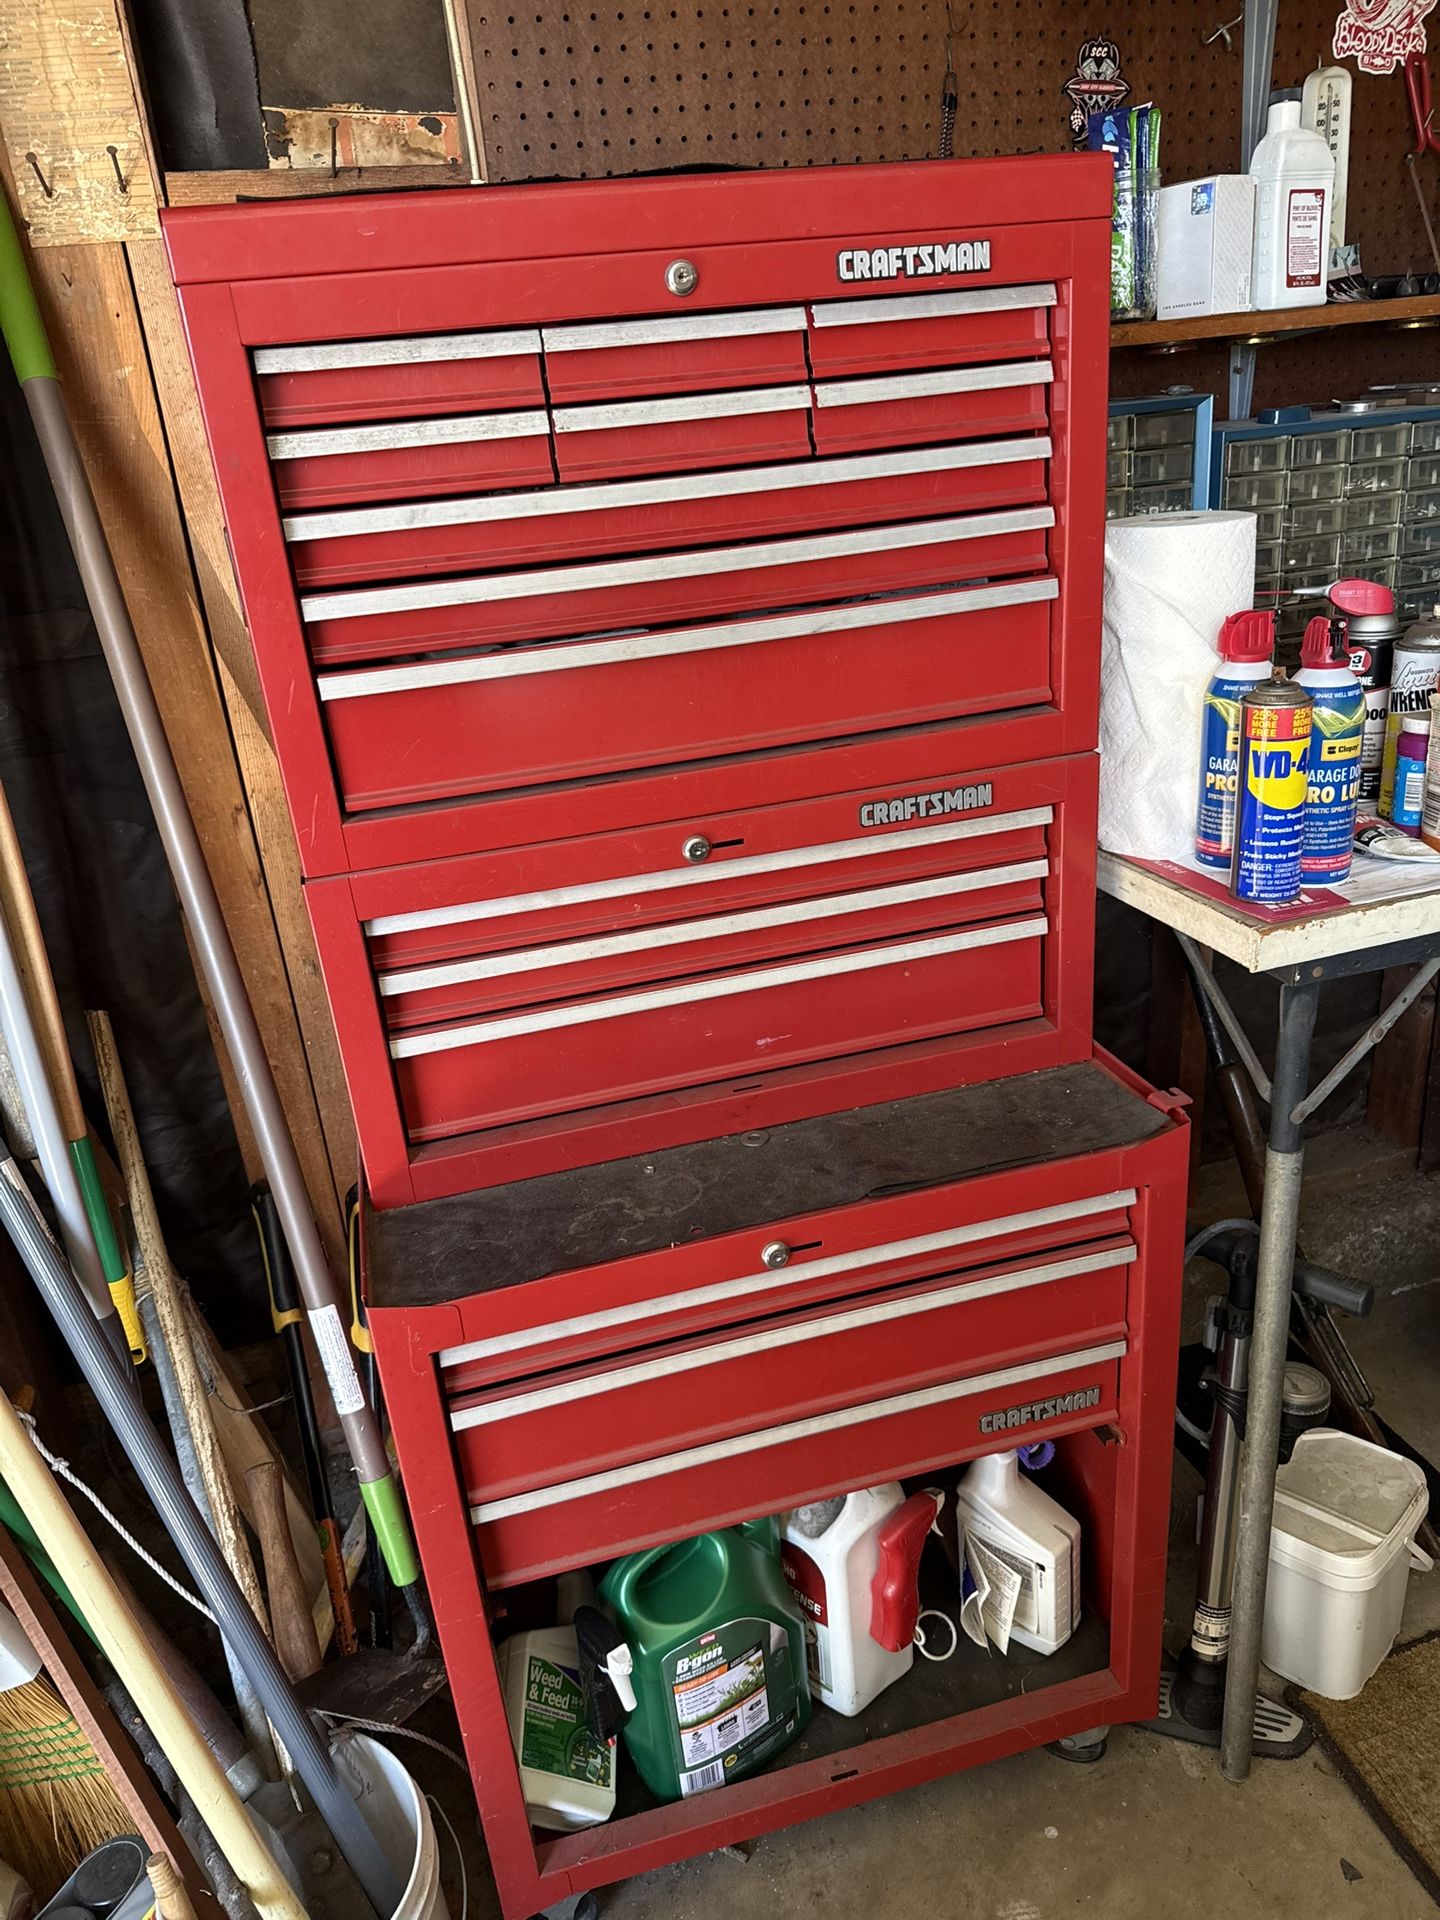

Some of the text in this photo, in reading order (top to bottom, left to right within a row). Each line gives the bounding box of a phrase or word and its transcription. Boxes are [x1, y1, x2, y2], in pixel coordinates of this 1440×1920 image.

[1090, 47, 1108, 57] SCC
[1332, 99, 1340, 107] 50
[1331, 114, 1339, 122] 40
[1329, 143, 1338, 151] 20
[838, 240, 991, 281] CRAFTSMAN
[1252, 709, 1278, 721] 25%
[1252, 720, 1277, 729] MORE
[1252, 728, 1277, 737] FREE
[1338, 743, 1360, 753] Clopay
[861, 783, 993, 827] CRAFTSMAN
[981, 1386, 1101, 1434] CRAFTSMAN
[790, 1587, 822, 1617] ENSE
[689, 1643, 719, 1660] WEED
[530, 1665, 563, 1690] Weed
[529, 1683, 539, 1700] &
[541, 1686, 570, 1709] Feed
